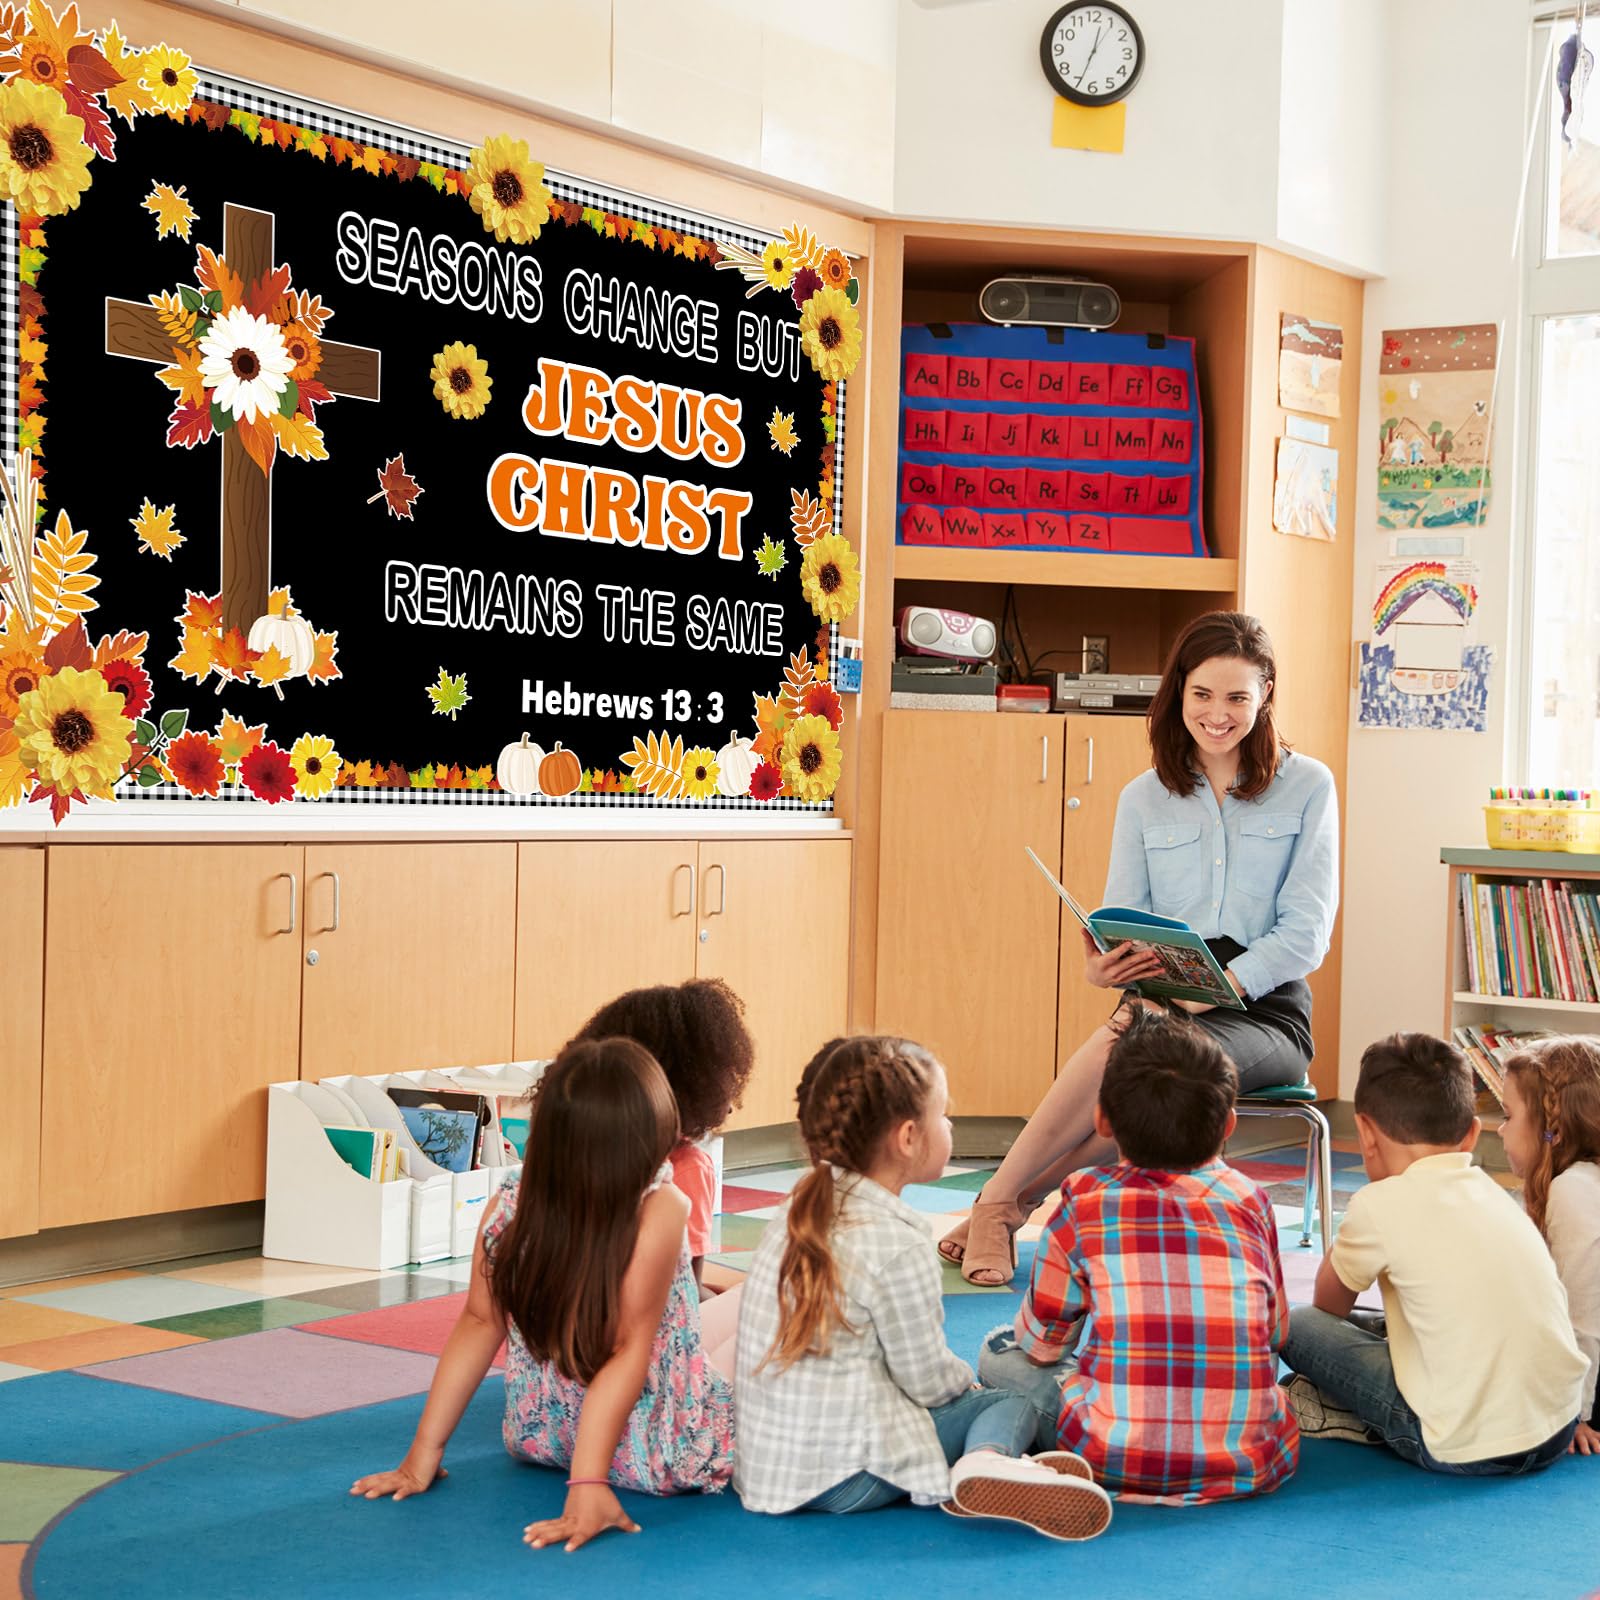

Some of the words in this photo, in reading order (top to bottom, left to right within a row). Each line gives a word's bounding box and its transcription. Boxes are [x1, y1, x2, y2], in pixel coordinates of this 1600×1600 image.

[1070, 15, 1083, 27] 11
[1085, 10, 1102, 23] 12
[1058, 28, 1076, 41] 10
[1117, 29, 1127, 42] 2
[1053, 43, 1065, 57] 9
[1121, 47, 1133, 61] 3
[1058, 61, 1070, 76] 8
[1116, 64, 1127, 77] 4
[1073, 76, 1083, 88] 7
[1087, 80, 1098, 94] 6
[1105, 77, 1115, 89] 5
[336, 211, 543, 324] SEASONS
[564, 268, 719, 364] CHANGE
[736, 310, 802, 383] BUT
[914, 367, 939, 385] Aa
[956, 369, 980, 388] Bb
[1000, 371, 1024, 390] Cc
[1038, 373, 1063, 392] Dd
[1079, 375, 1099, 393] Ee
[1126, 378, 1144, 396] Ff
[1156, 376, 1182, 401] Gg
[522, 357, 746, 470] JESUS
[915, 423, 939, 440] Hh
[1001, 424, 1017, 446] Jj
[1040, 428, 1060, 445] Kk
[1115, 431, 1146, 448] Mm
[1161, 431, 1184, 450] Nn
[909, 477, 936, 495] Oo
[954, 477, 976, 499] Pp
[988, 478, 1017, 501] Qq
[1039, 481, 1059, 499] Rr
[1080, 483, 1100, 501] Ss
[1124, 487, 1140, 503] Tt
[1158, 488, 1178, 505] Uu
[487, 453, 754, 562] CHRIST
[913, 516, 934, 534] Vv
[946, 518, 979, 536] Ww
[991, 524, 1016, 538] Xx
[1035, 520, 1057, 539] Yy
[1080, 523, 1100, 540] Zz
[384, 560, 583, 638] REMAINS
[596, 584, 675, 647] THE
[686, 594, 785, 657] SAME
[521, 678, 654, 721] Hebrews
